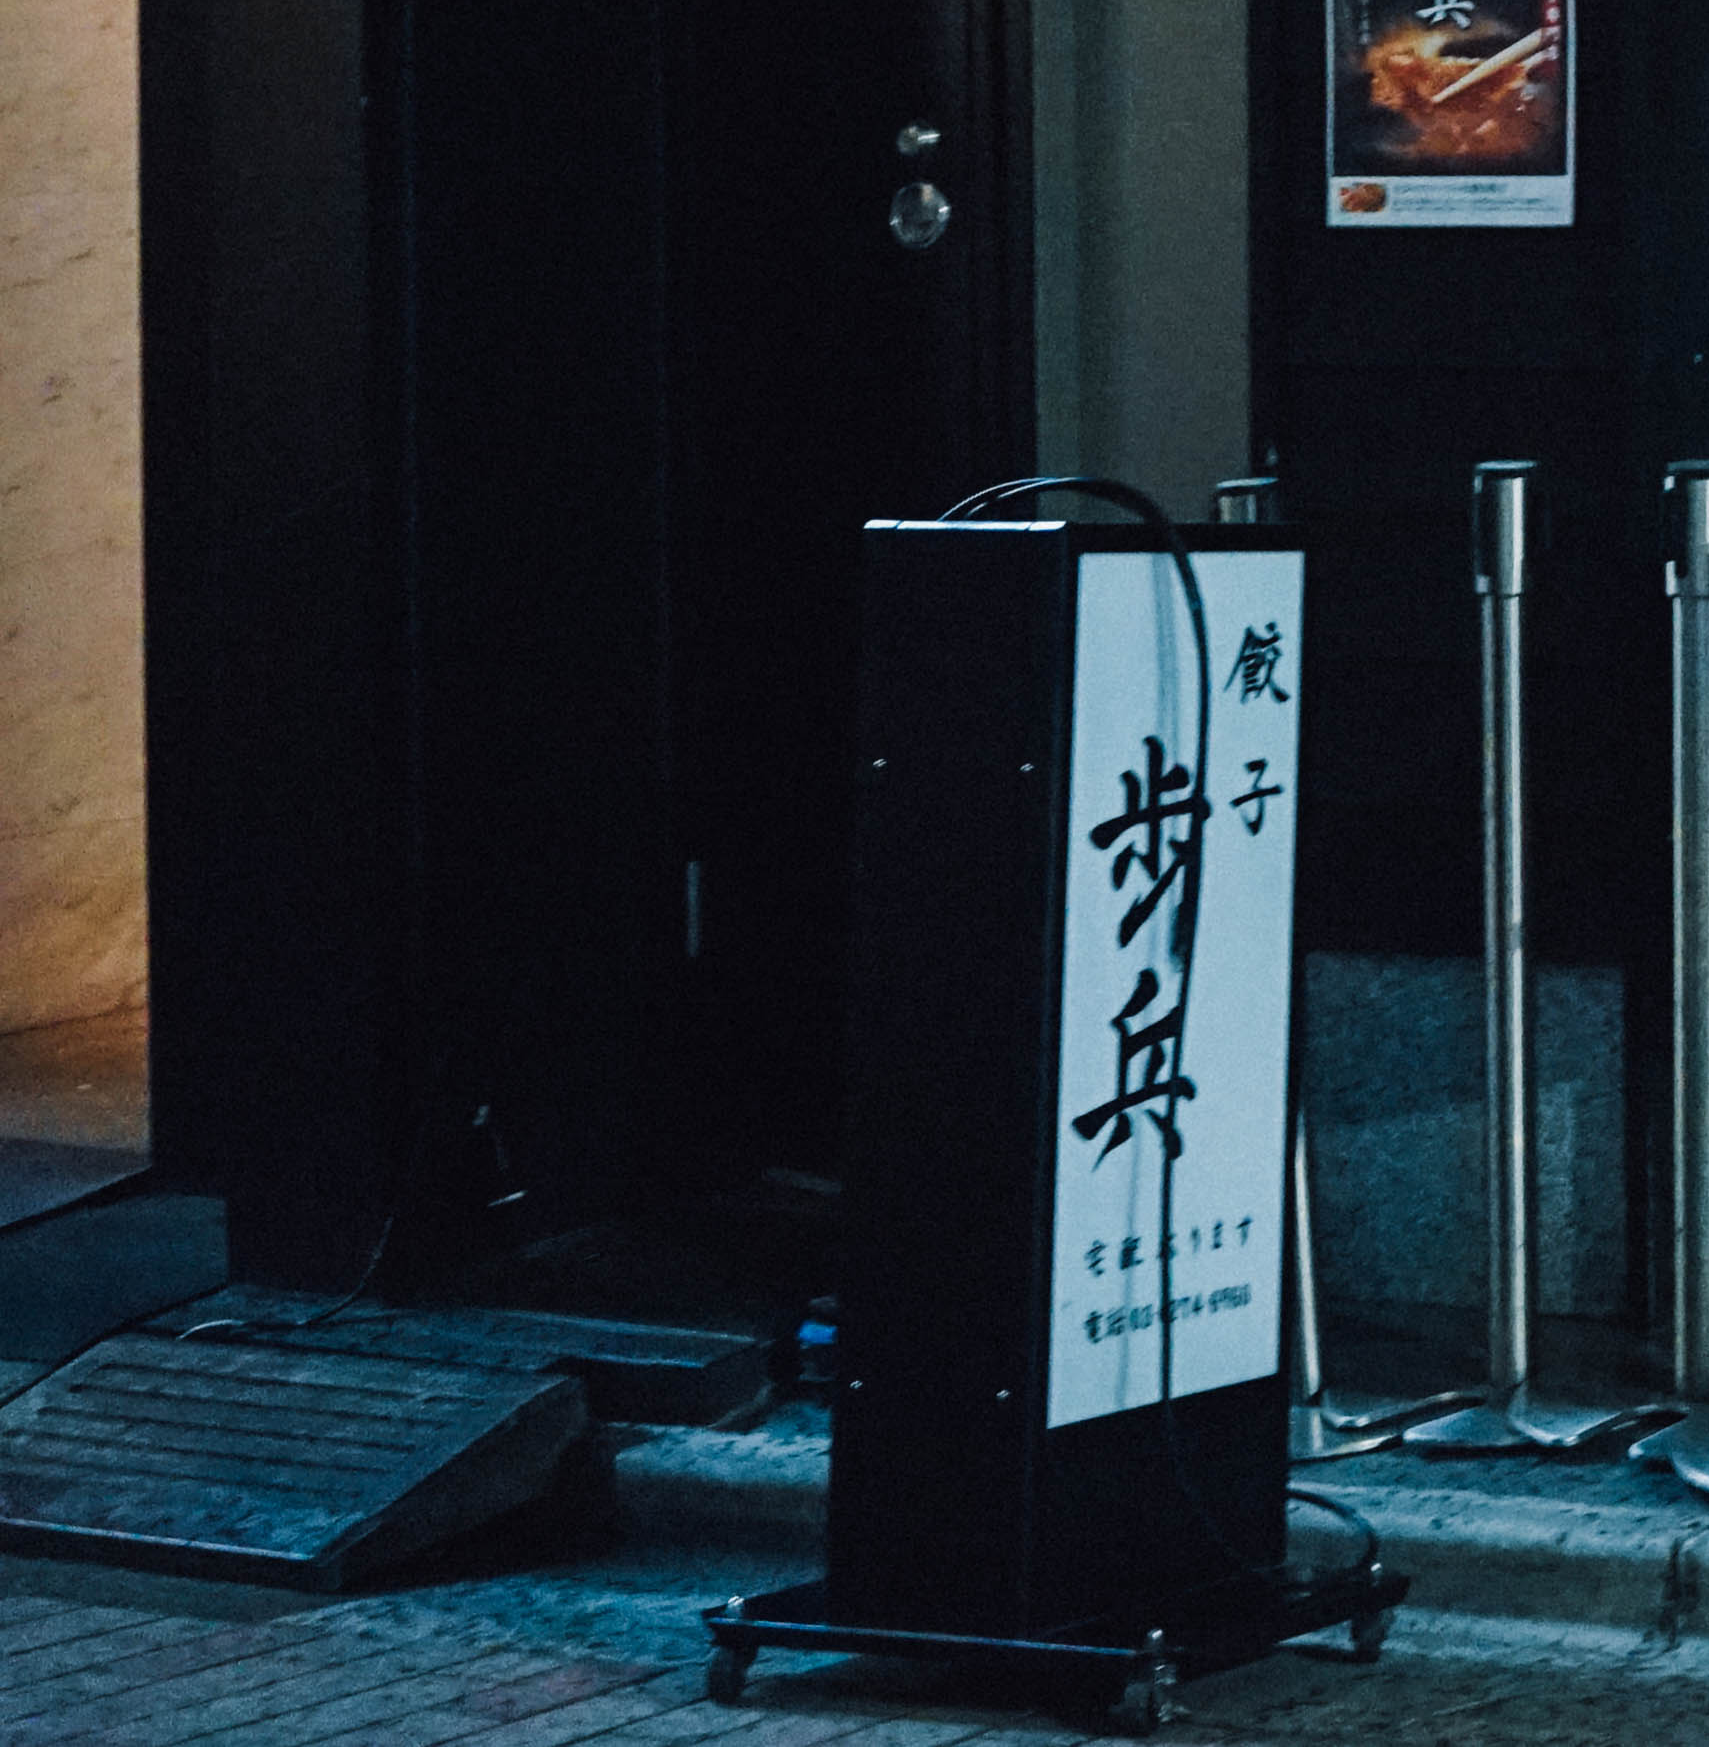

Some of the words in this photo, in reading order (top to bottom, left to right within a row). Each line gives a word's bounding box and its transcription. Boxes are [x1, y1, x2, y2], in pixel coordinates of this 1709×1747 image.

[1221, 621, 1291, 837] 餃子
[1071, 733, 1213, 1174] 歩兵
[1084, 1215, 1254, 1278] 宅配ります
